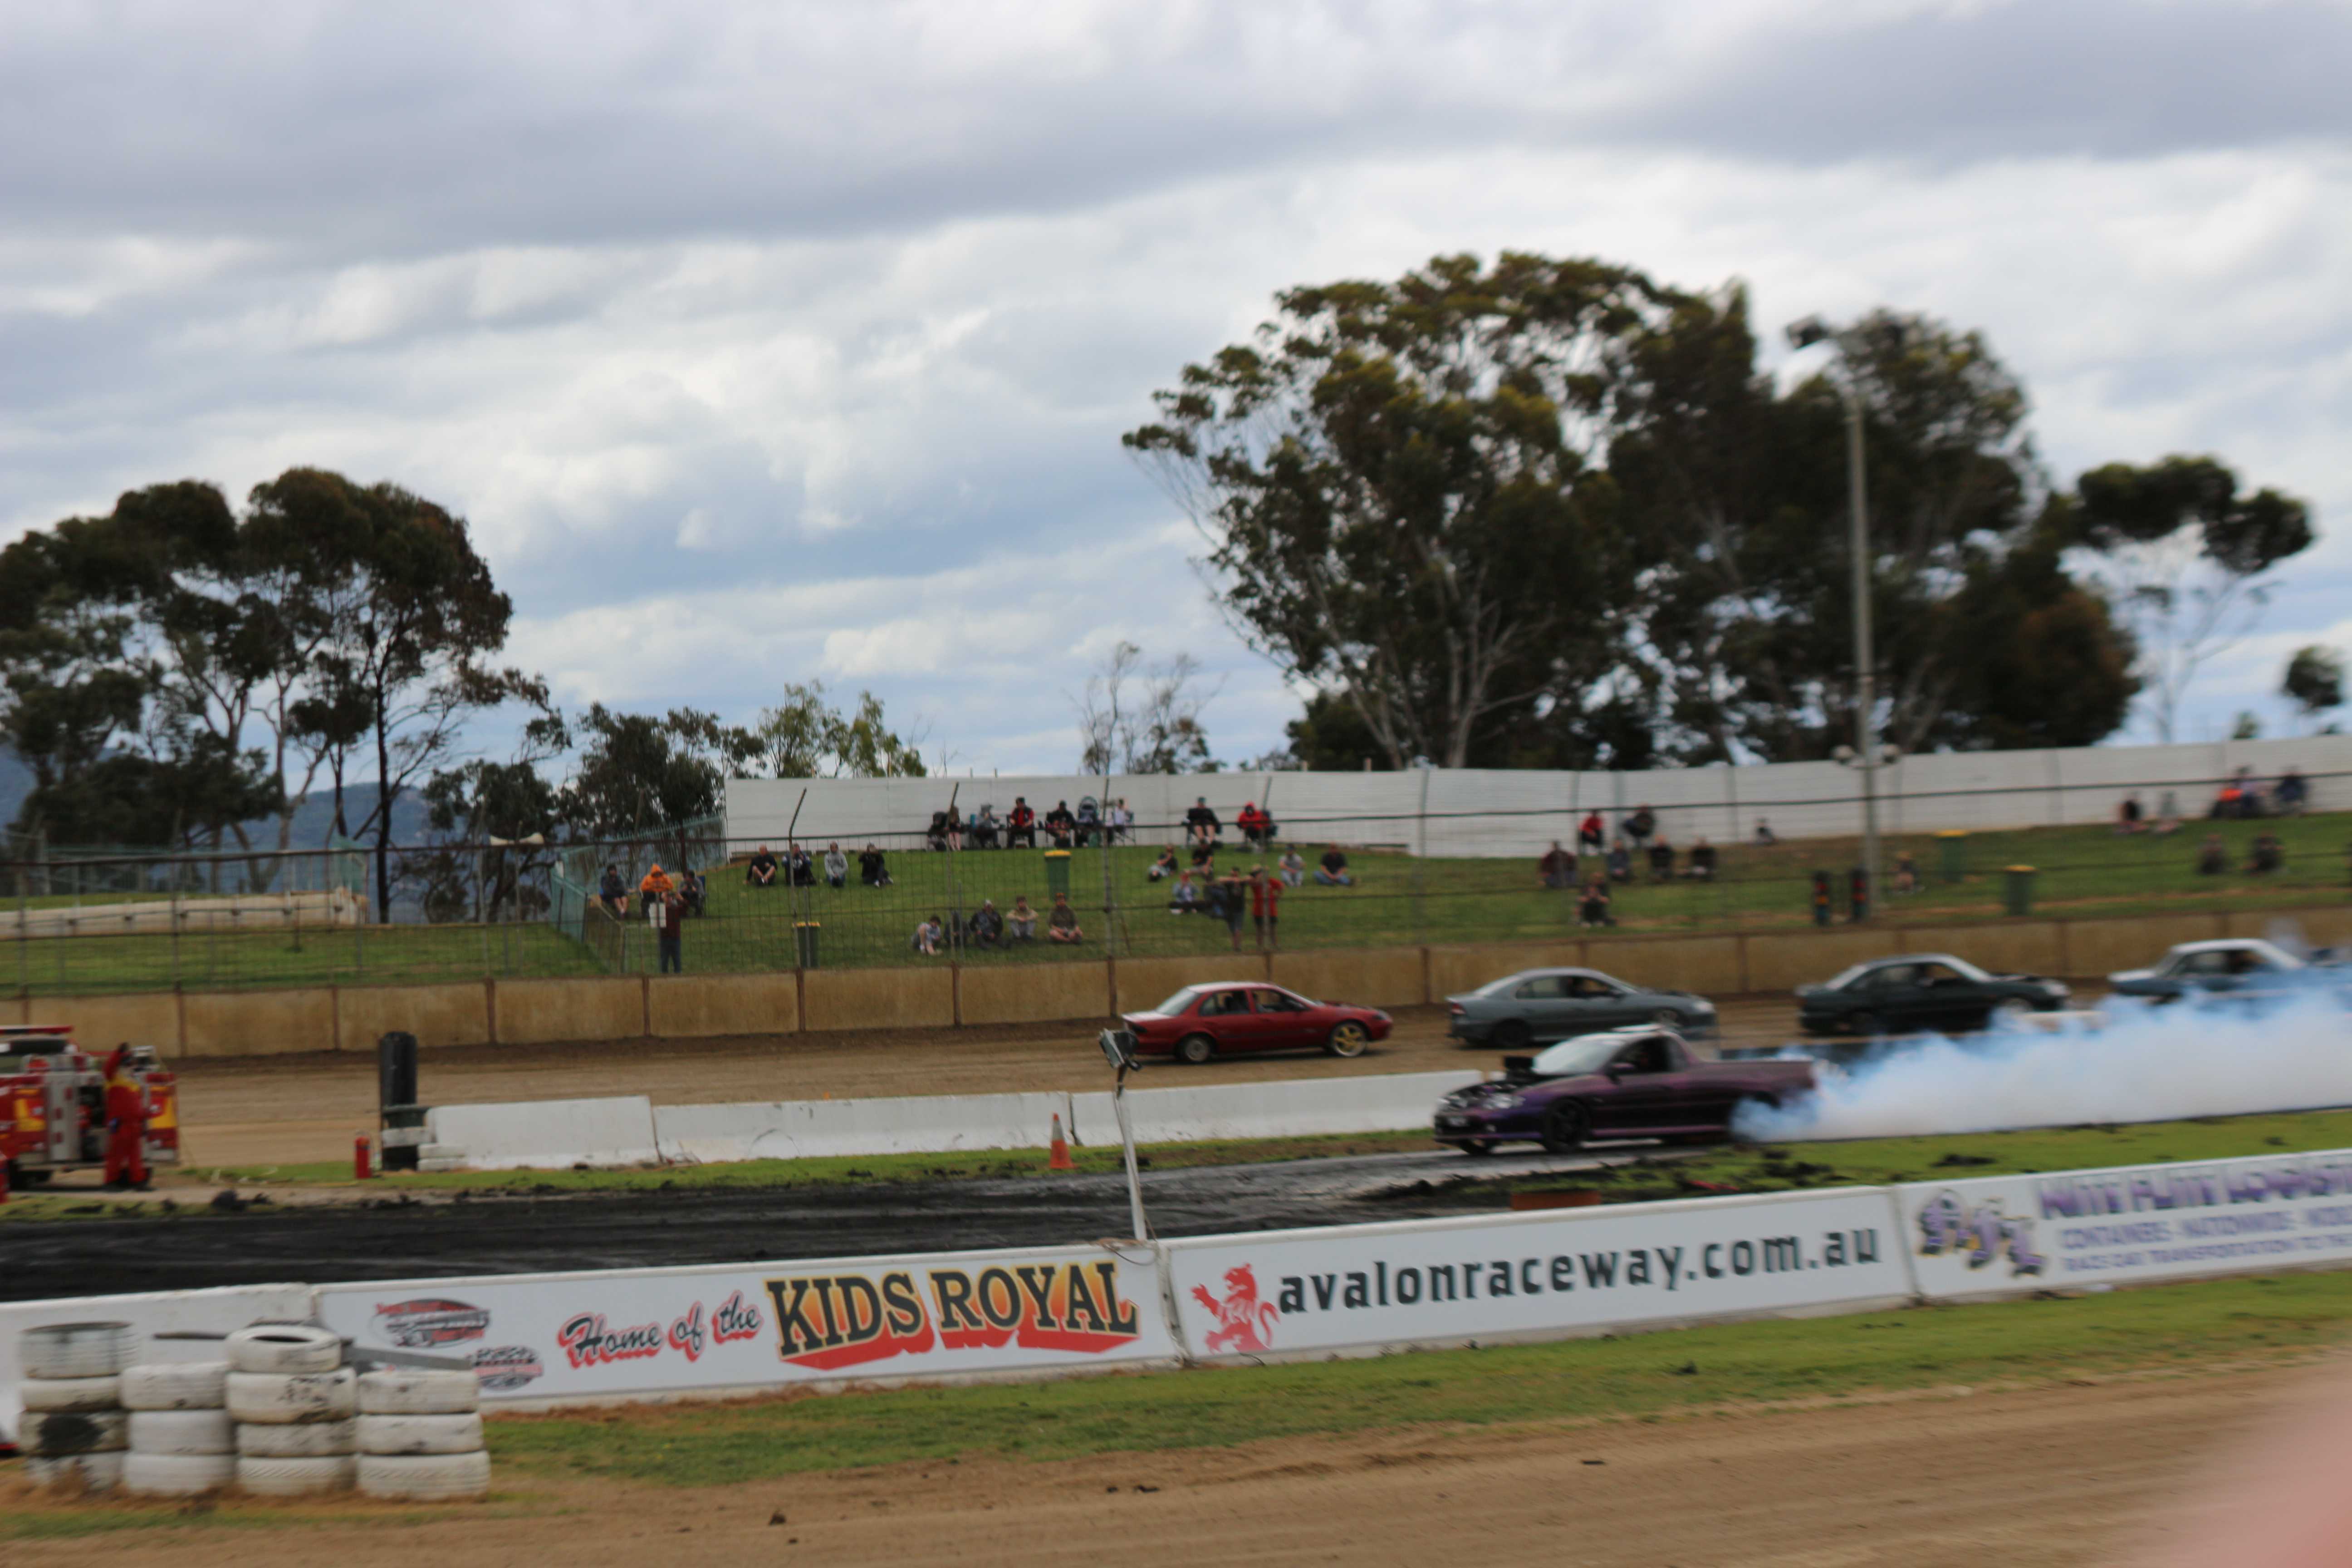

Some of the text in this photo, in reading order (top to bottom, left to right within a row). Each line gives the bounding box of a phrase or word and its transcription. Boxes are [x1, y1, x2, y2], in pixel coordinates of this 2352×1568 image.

[561, 1260, 1140, 1363] Home of the KIDS ROYAL
[1279, 1228, 1881, 1313] avalonraceway.com.au
